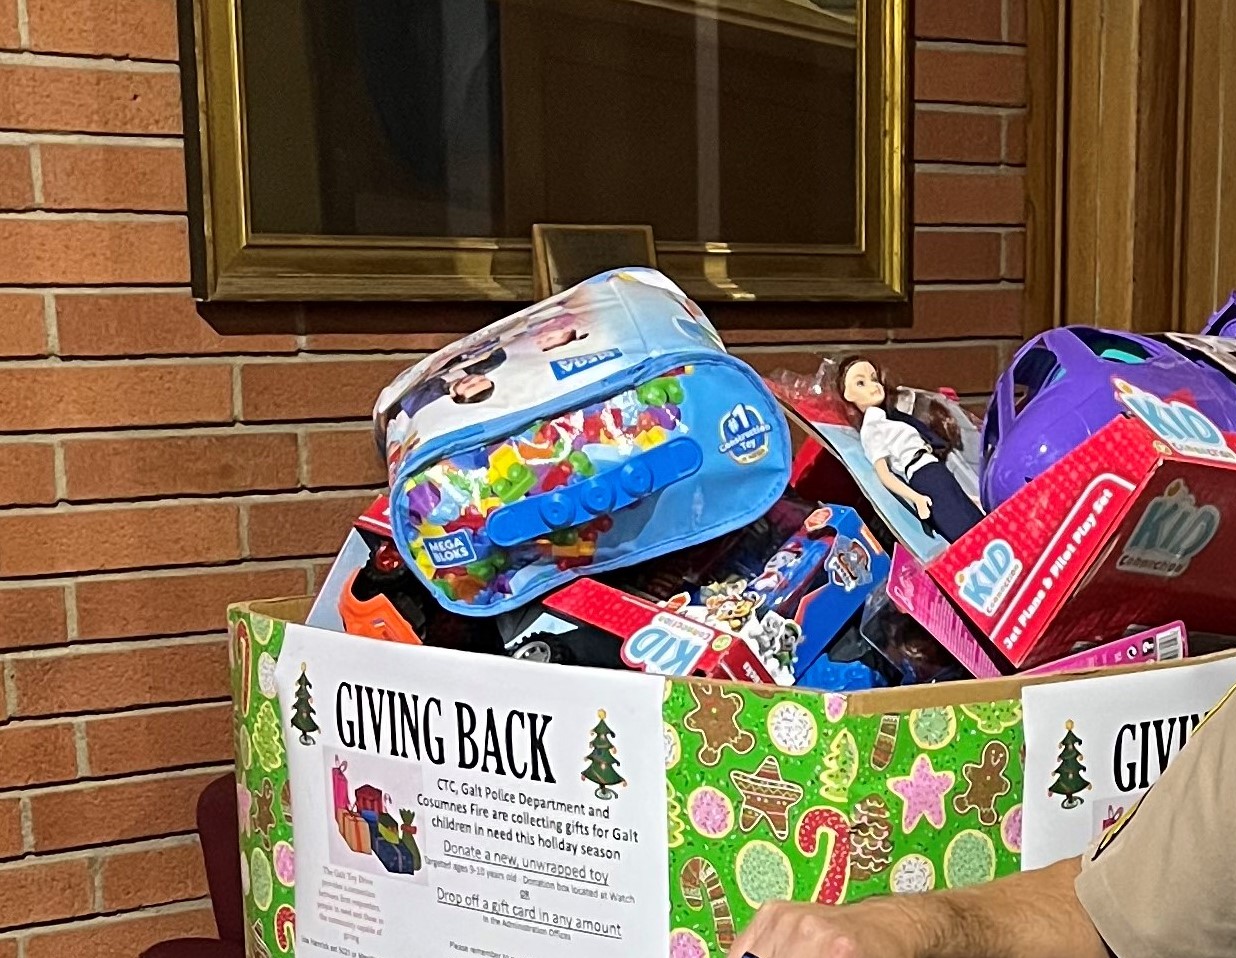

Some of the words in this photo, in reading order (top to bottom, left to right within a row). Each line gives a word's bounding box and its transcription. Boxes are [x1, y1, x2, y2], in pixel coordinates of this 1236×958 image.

[728, 404, 749, 433] #1
[1127, 398, 1221, 446] KID
[740, 439, 755, 450] Toy
[429, 538, 464, 551] MEGA
[1130, 501, 1215, 556] KID
[433, 547, 468, 562] BLOKS
[963, 543, 1011, 607] KID
[1003, 625, 1022, 650] Jet
[1018, 589, 1046, 628] Plane
[1050, 543, 1077, 579] Pilot
[1072, 512, 1097, 544] Play
[1092, 488, 1113, 514] Set
[630, 628, 702, 676] KID
[336, 681, 445, 765] GIVING
[455, 701, 557, 783] BACK
[1113, 710, 1211, 792] GIVI
[417, 794, 467, 814] Cosumnes
[470, 803, 489, 819] Fire
[492, 809, 508, 822] are
[511, 810, 563, 834] collecting
[565, 819, 589, 836] gifts
[592, 823, 609, 839] for
[612, 828, 639, 843] Galt
[437, 778, 458, 795] CTC,
[461, 783, 482, 797] Galt
[485, 788, 515, 803] Police
[519, 793, 586, 816] Department
[588, 805, 610, 819] and
[431, 816, 471, 834] children
[474, 822, 484, 836] in
[487, 826, 512, 841] need
[515, 829, 535, 846] this
[538, 833, 578, 856] holiday
[581, 843, 621, 860] season
[443, 840, 481, 859] Donate
[484, 850, 491, 860] a
[494, 851, 519, 868] new,
[522, 858, 586, 881] unwrapped
[589, 868, 609, 885] toy
[437, 887, 462, 905] Drop
[465, 892, 480, 907] off
[482, 899, 489, 910] a
[492, 900, 509, 914] gift
[512, 903, 536, 920] card
[539, 907, 549, 922] in
[552, 913, 572, 929] any
[575, 918, 622, 936] amount
